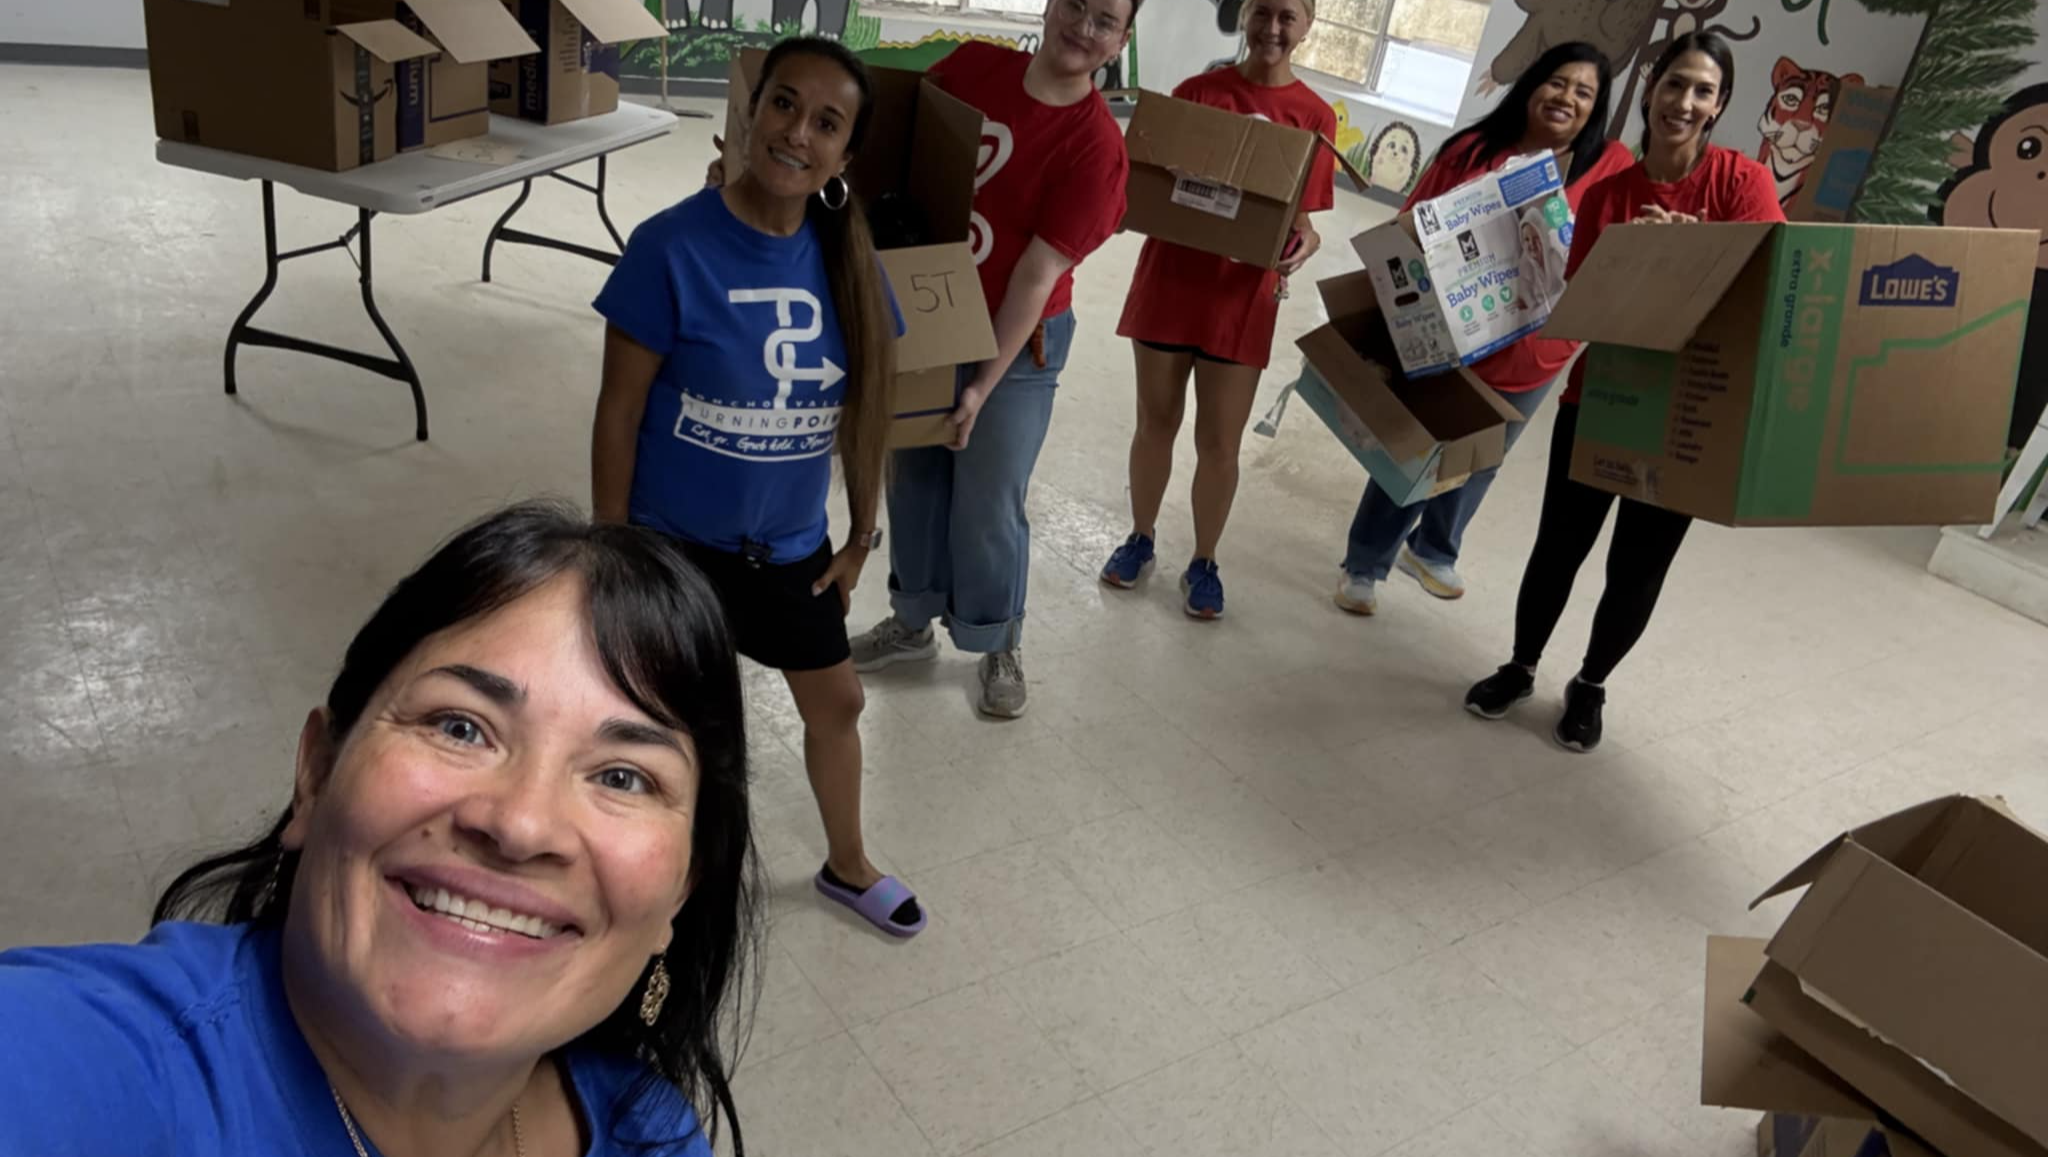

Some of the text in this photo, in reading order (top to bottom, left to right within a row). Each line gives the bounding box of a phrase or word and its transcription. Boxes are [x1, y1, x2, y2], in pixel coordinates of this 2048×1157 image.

[1445, 200, 1502, 232] Baby Wipes
[909, 270, 957, 313] 5T
[1446, 266, 1520, 308] Baby Wipes
[1779, 249, 1803, 349] extra grande
[1869, 273, 1949, 302] LOWE'S
[1783, 246, 1835, 413] x-large
[793, 411, 840, 429] POIN
